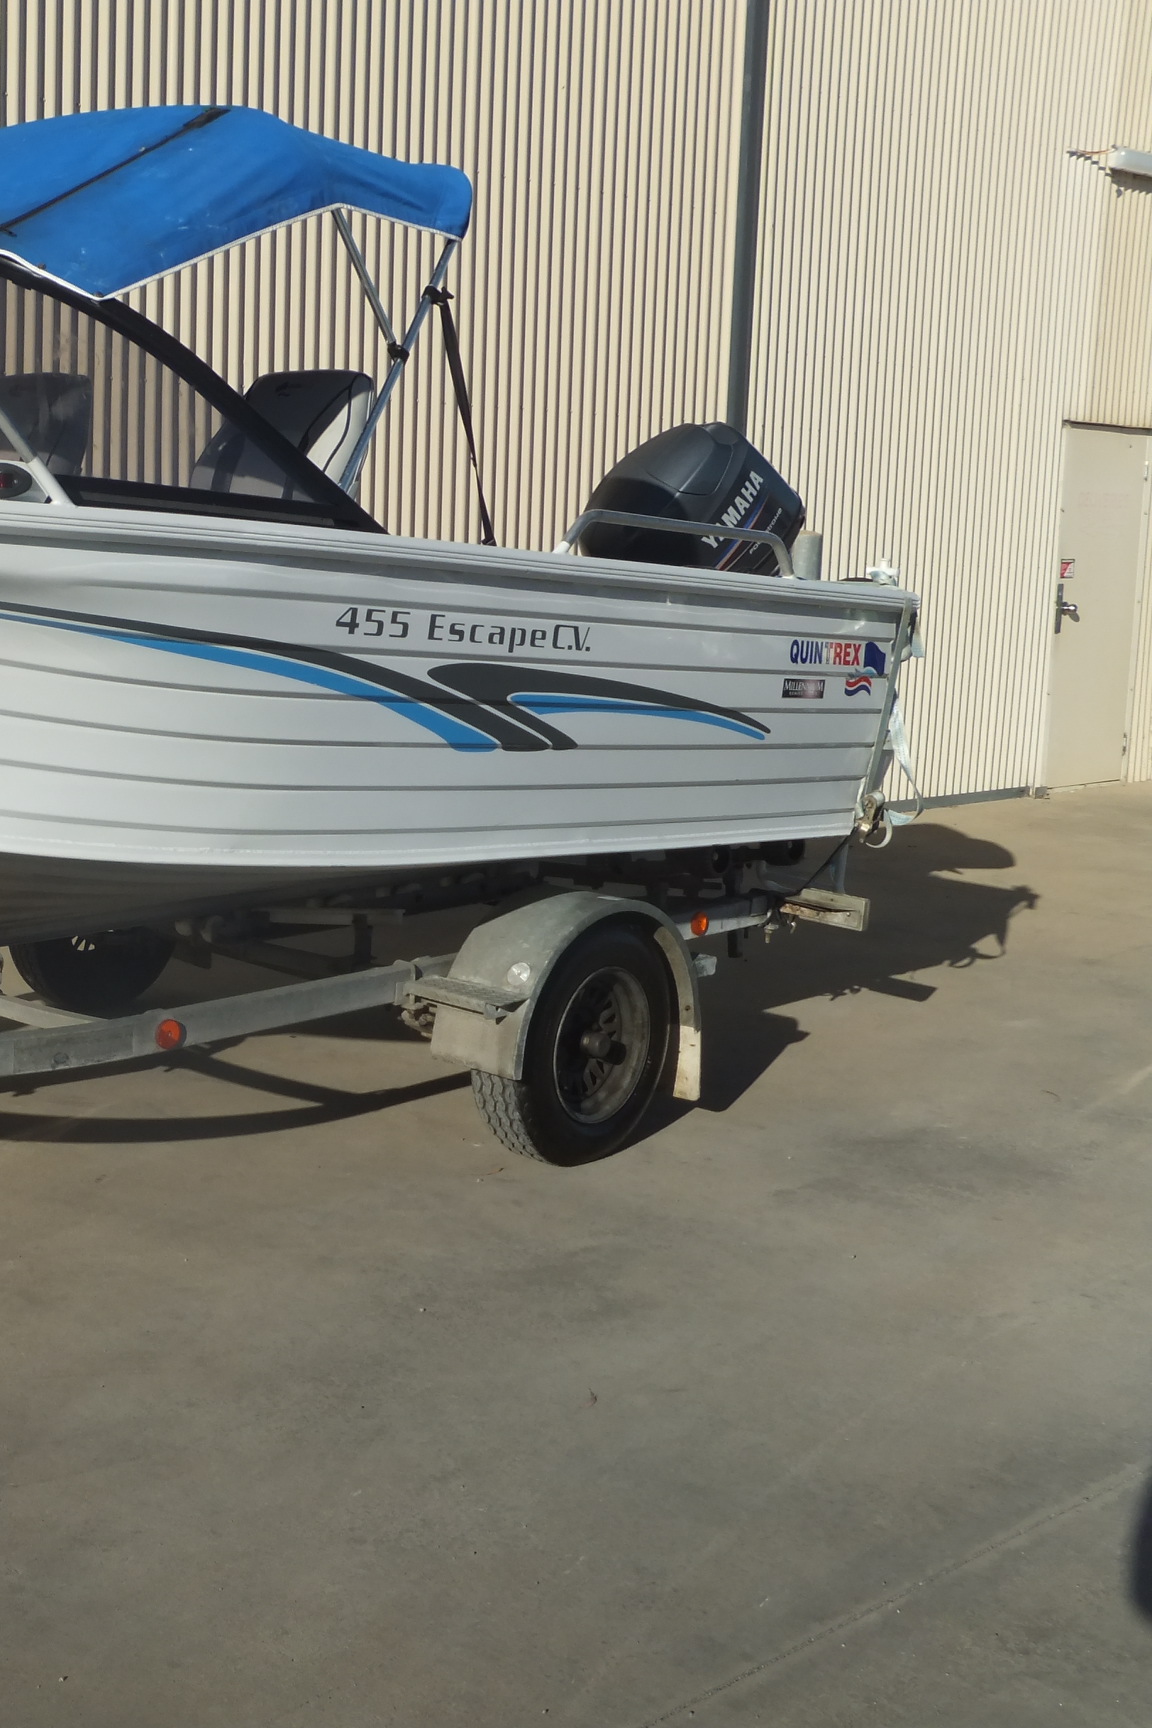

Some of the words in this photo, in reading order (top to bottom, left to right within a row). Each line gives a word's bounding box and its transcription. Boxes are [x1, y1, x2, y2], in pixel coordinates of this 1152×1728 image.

[701, 470, 764, 549] YMAHA
[335, 607, 411, 639] 455
[427, 613, 547, 653] Escape
[790, 639, 862, 666] QUINTREX
